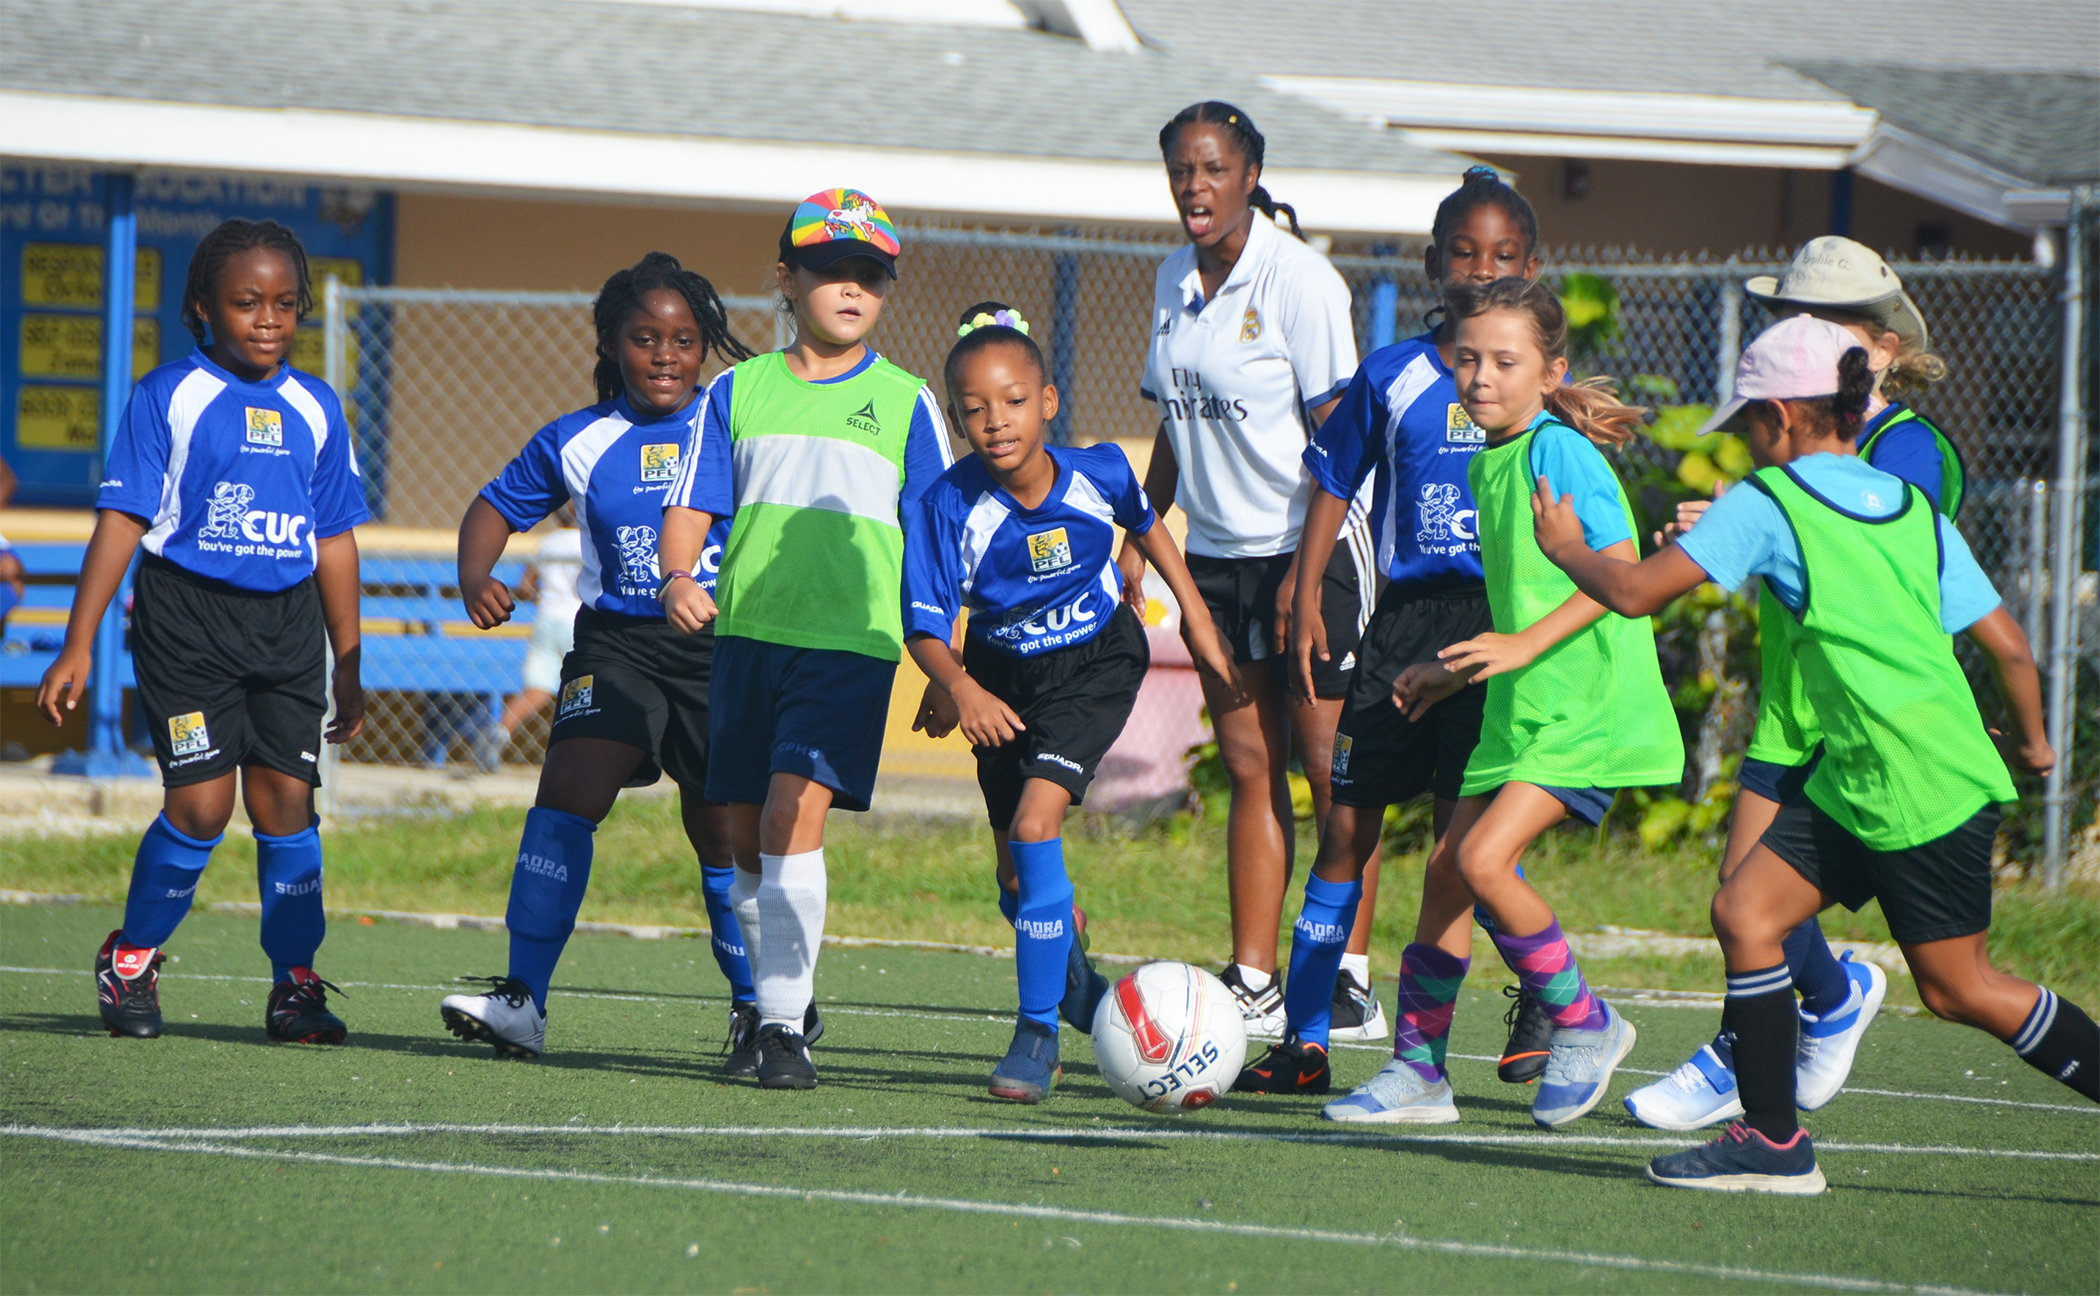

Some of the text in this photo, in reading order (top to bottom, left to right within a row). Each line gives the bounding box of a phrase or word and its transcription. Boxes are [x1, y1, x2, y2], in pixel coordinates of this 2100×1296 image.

[1171, 368, 1202, 392] Fly
[846, 417, 881, 436] SELECT
[1450, 430, 1485, 441] PFL
[241, 509, 306, 547] CUC
[198, 539, 303, 560] You've got the power
[1448, 542, 1467, 557] got
[1468, 542, 1481, 552] th
[1034, 556, 1070, 570] PFL
[911, 600, 945, 616] QUADR
[1020, 639, 1041, 654] got
[1042, 635, 1063, 648] the
[1064, 621, 1098, 645] power
[1136, 1040, 1219, 1101] SELECT
